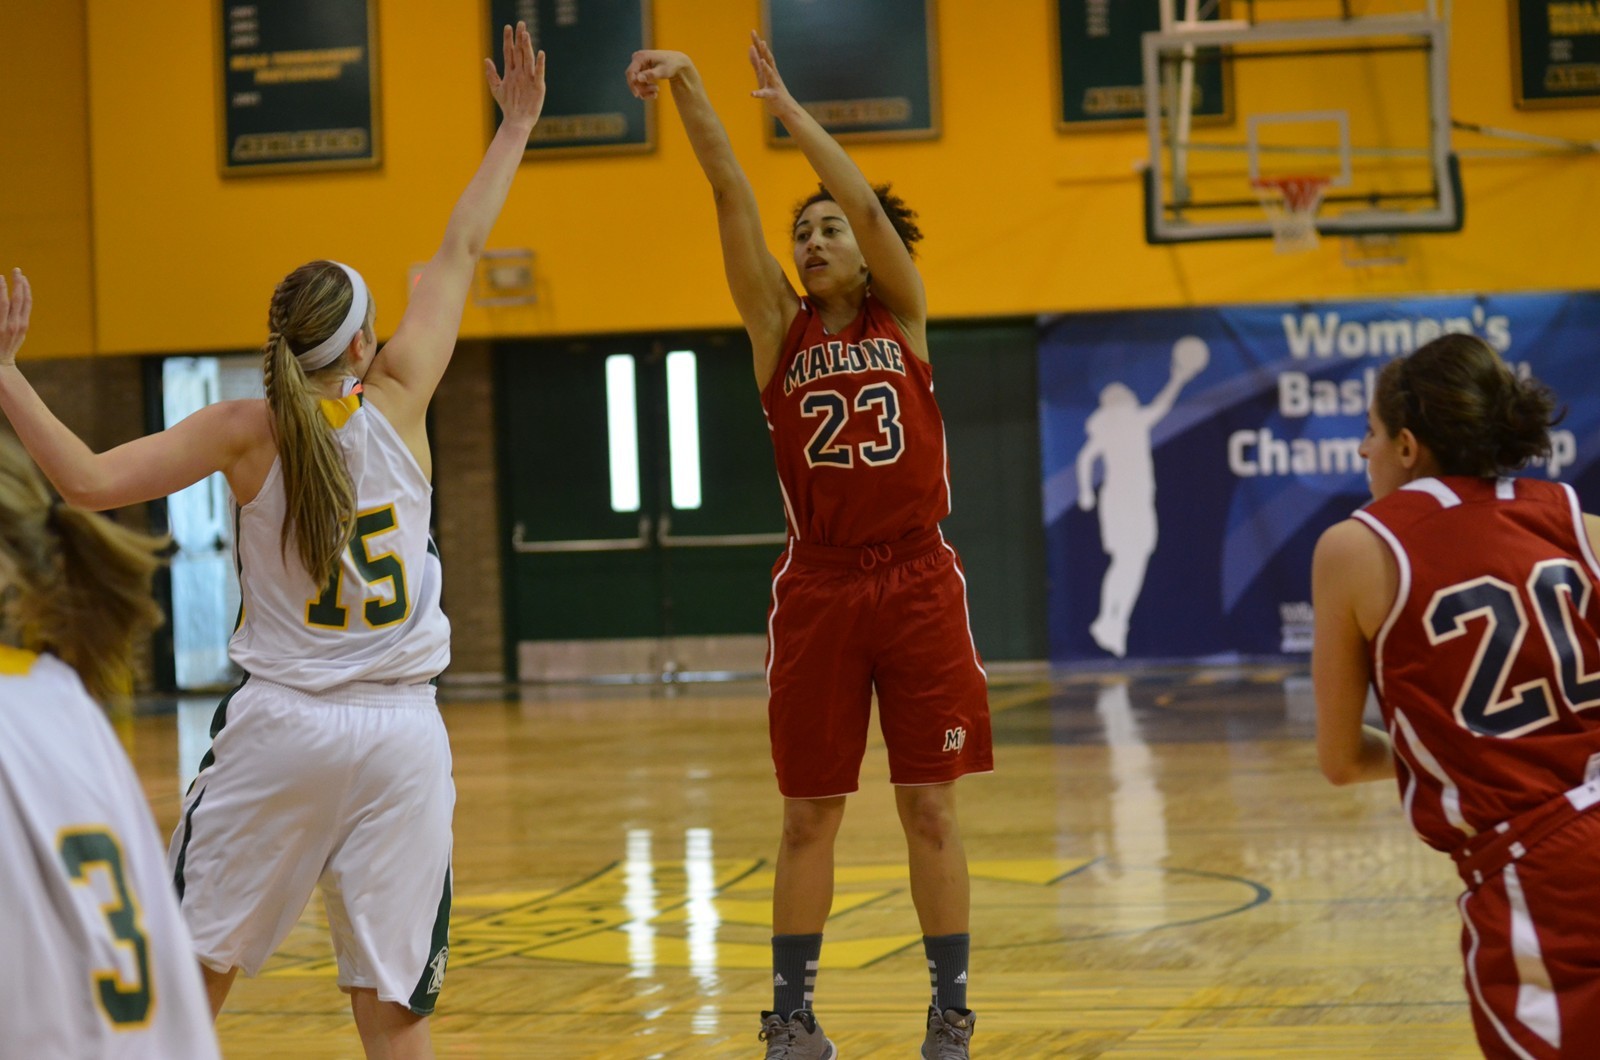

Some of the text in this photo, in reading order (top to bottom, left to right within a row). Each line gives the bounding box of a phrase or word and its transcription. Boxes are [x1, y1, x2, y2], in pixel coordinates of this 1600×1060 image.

[783, 338, 906, 396] MALONE
[800, 381, 905, 469] 23
[304, 502, 411, 631] 15
[54, 824, 157, 1033] 3
